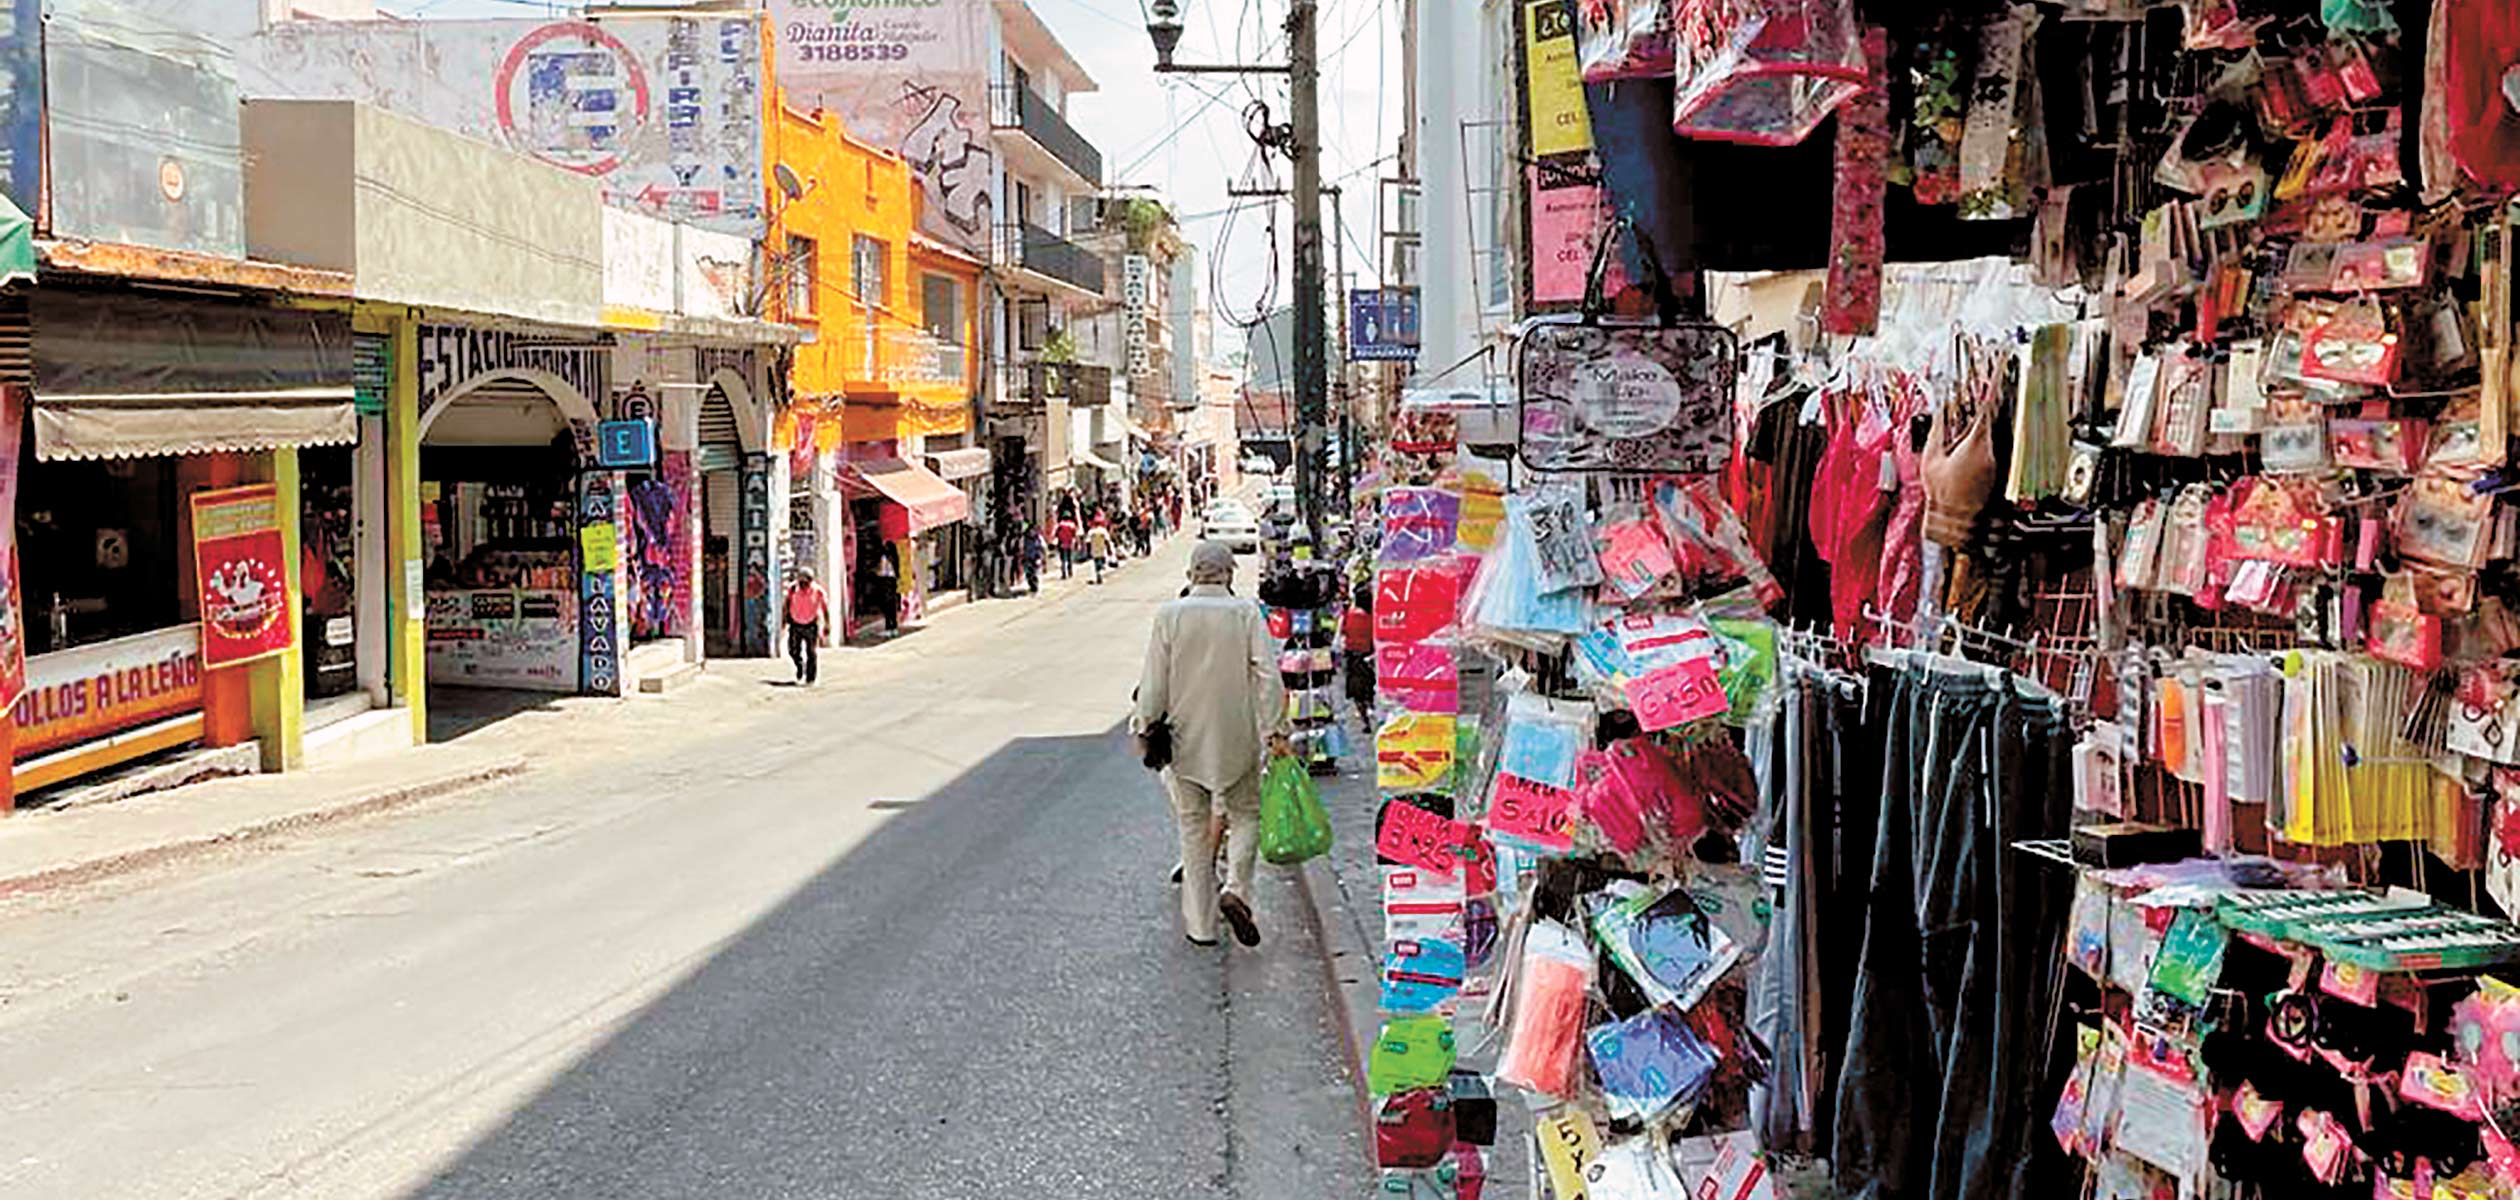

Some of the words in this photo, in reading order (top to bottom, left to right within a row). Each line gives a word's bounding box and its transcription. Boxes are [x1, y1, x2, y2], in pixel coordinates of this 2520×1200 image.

[786, 21, 876, 43] Dianita
[798, 43, 909, 62] 3188539
[616, 430, 631, 455] E
[96, 674, 111, 710] A
[117, 667, 142, 704] LA
[147, 650, 198, 697] LEÑA
